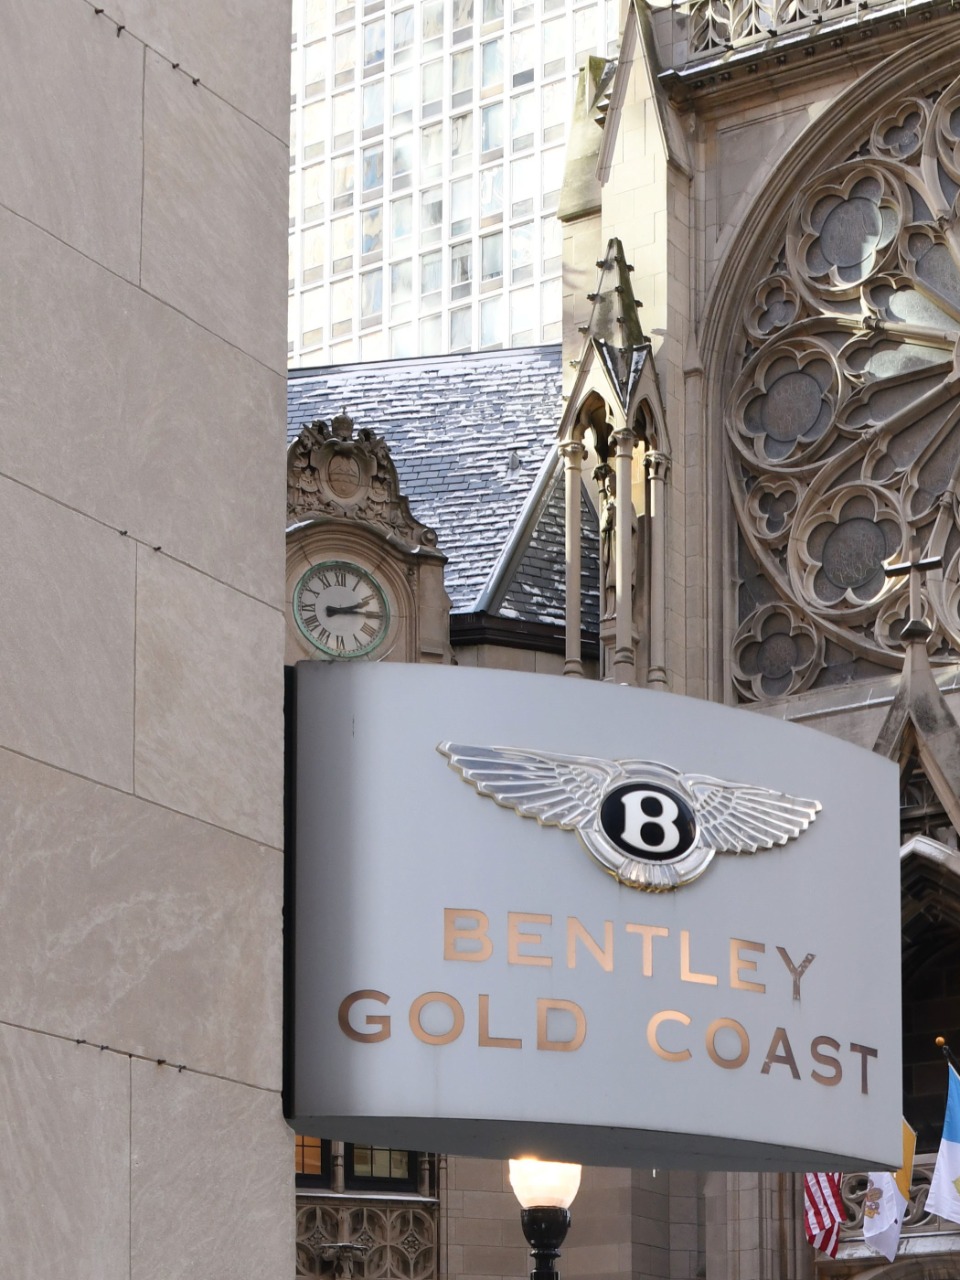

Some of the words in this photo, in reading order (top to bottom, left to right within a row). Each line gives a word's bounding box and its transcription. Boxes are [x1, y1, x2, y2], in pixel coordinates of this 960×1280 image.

[334, 571, 347, 588] XII
[620, 789, 681, 854] B
[443, 907, 817, 1002] BENTLEY
[337, 989, 588, 1053] GOLD
[646, 1009, 879, 1096] COAST
